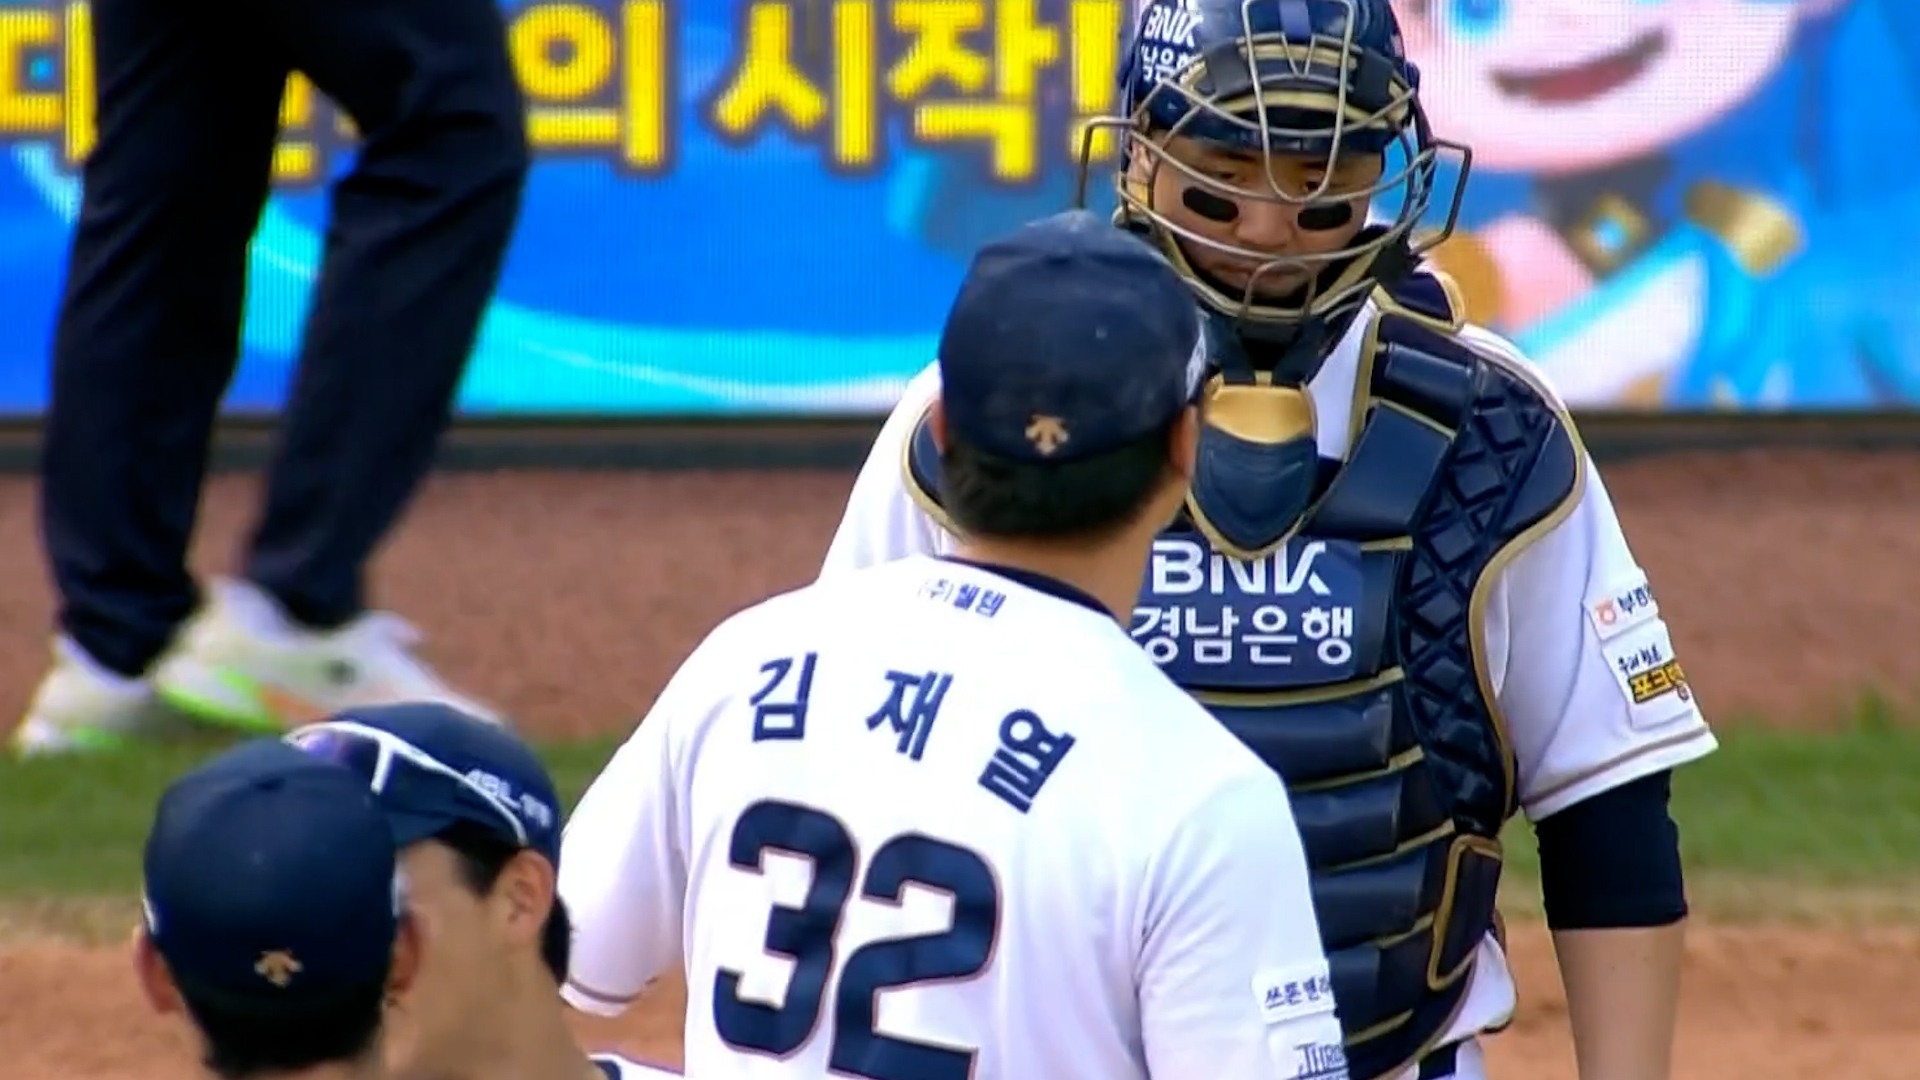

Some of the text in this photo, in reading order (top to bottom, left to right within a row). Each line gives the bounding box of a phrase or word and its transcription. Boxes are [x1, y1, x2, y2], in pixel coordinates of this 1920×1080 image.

[1143, 4, 1203, 49] BNK
[1152, 540, 1331, 594] BNK
[1131, 605, 1353, 665] 경남은행
[712, 798, 1004, 1079] 32
